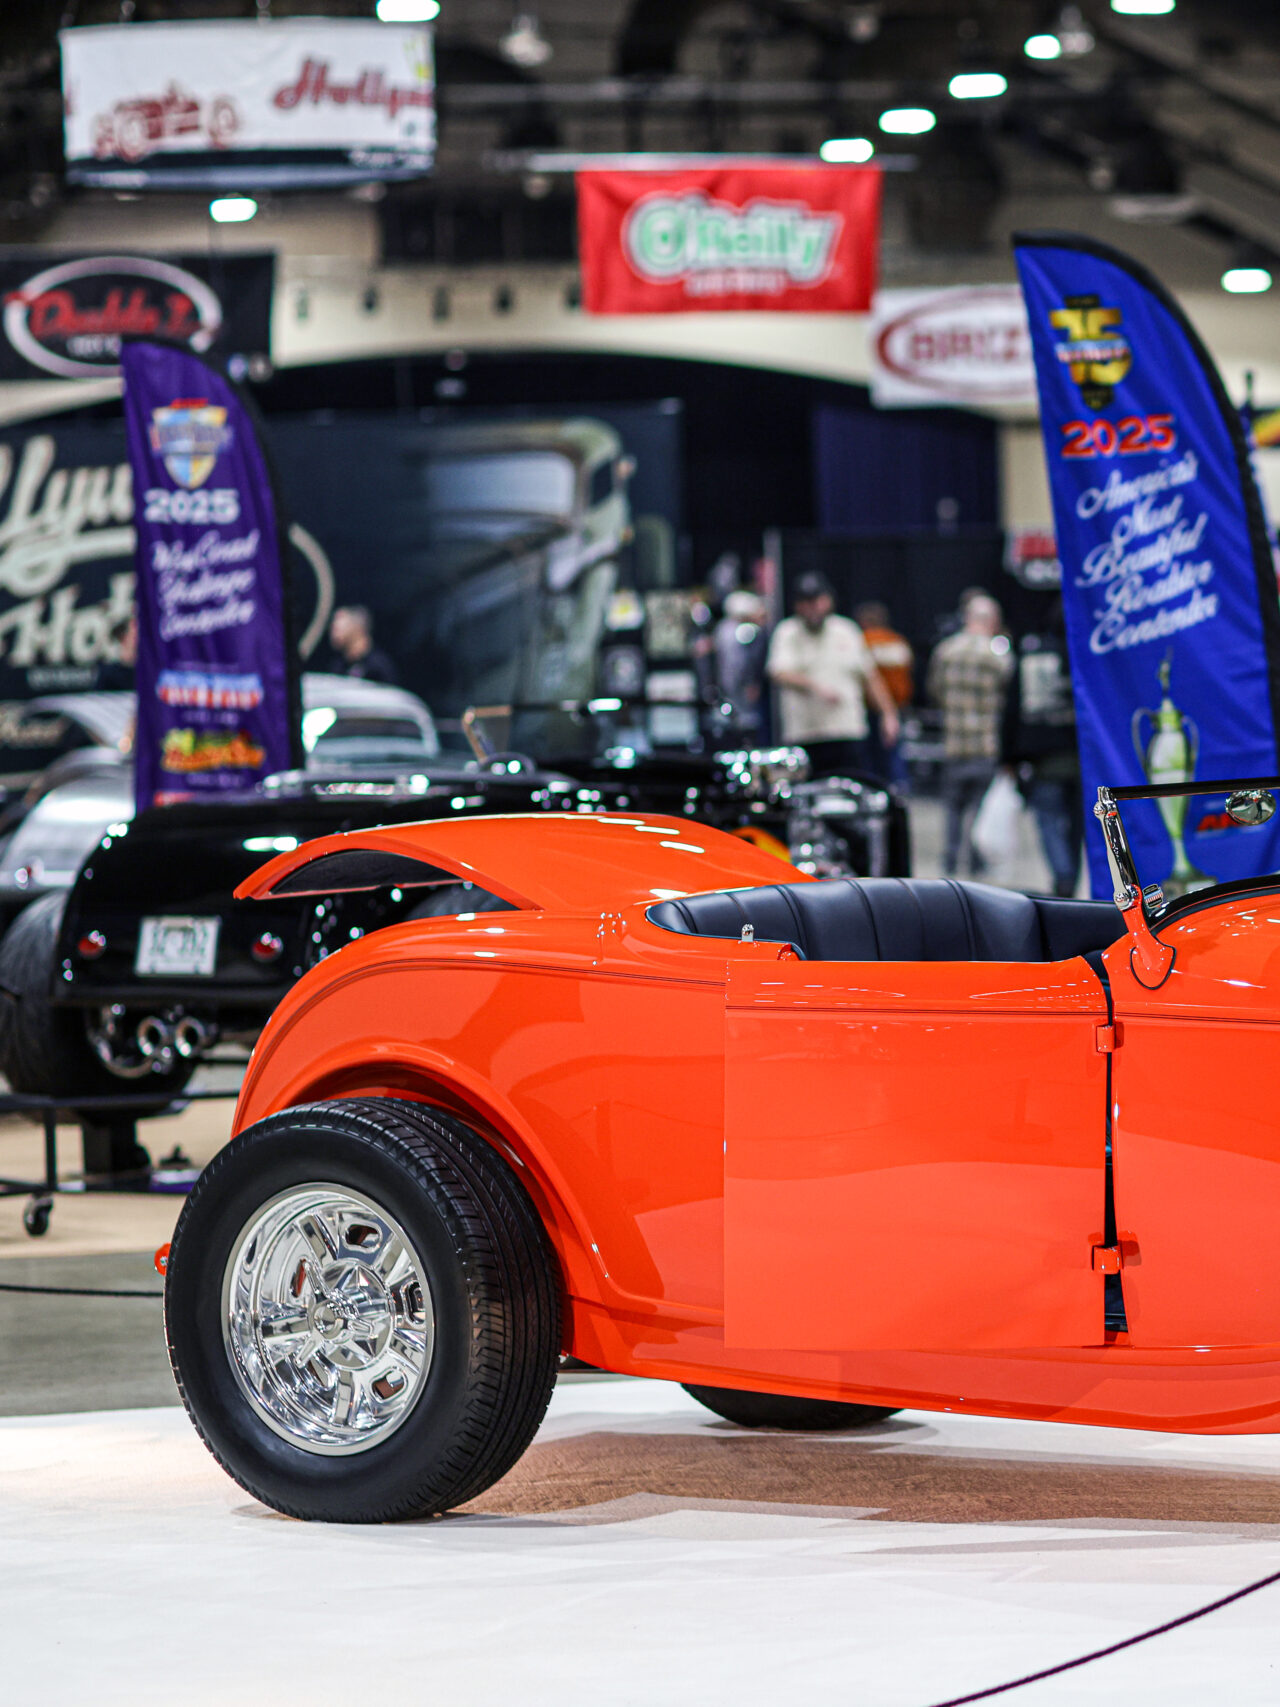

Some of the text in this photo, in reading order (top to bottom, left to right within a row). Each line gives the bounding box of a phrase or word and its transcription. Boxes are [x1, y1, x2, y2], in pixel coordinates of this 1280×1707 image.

[1060, 413, 1176, 459] 2025
[144, 487, 241, 526] 2025
[1089, 588, 1219, 655] Contender
